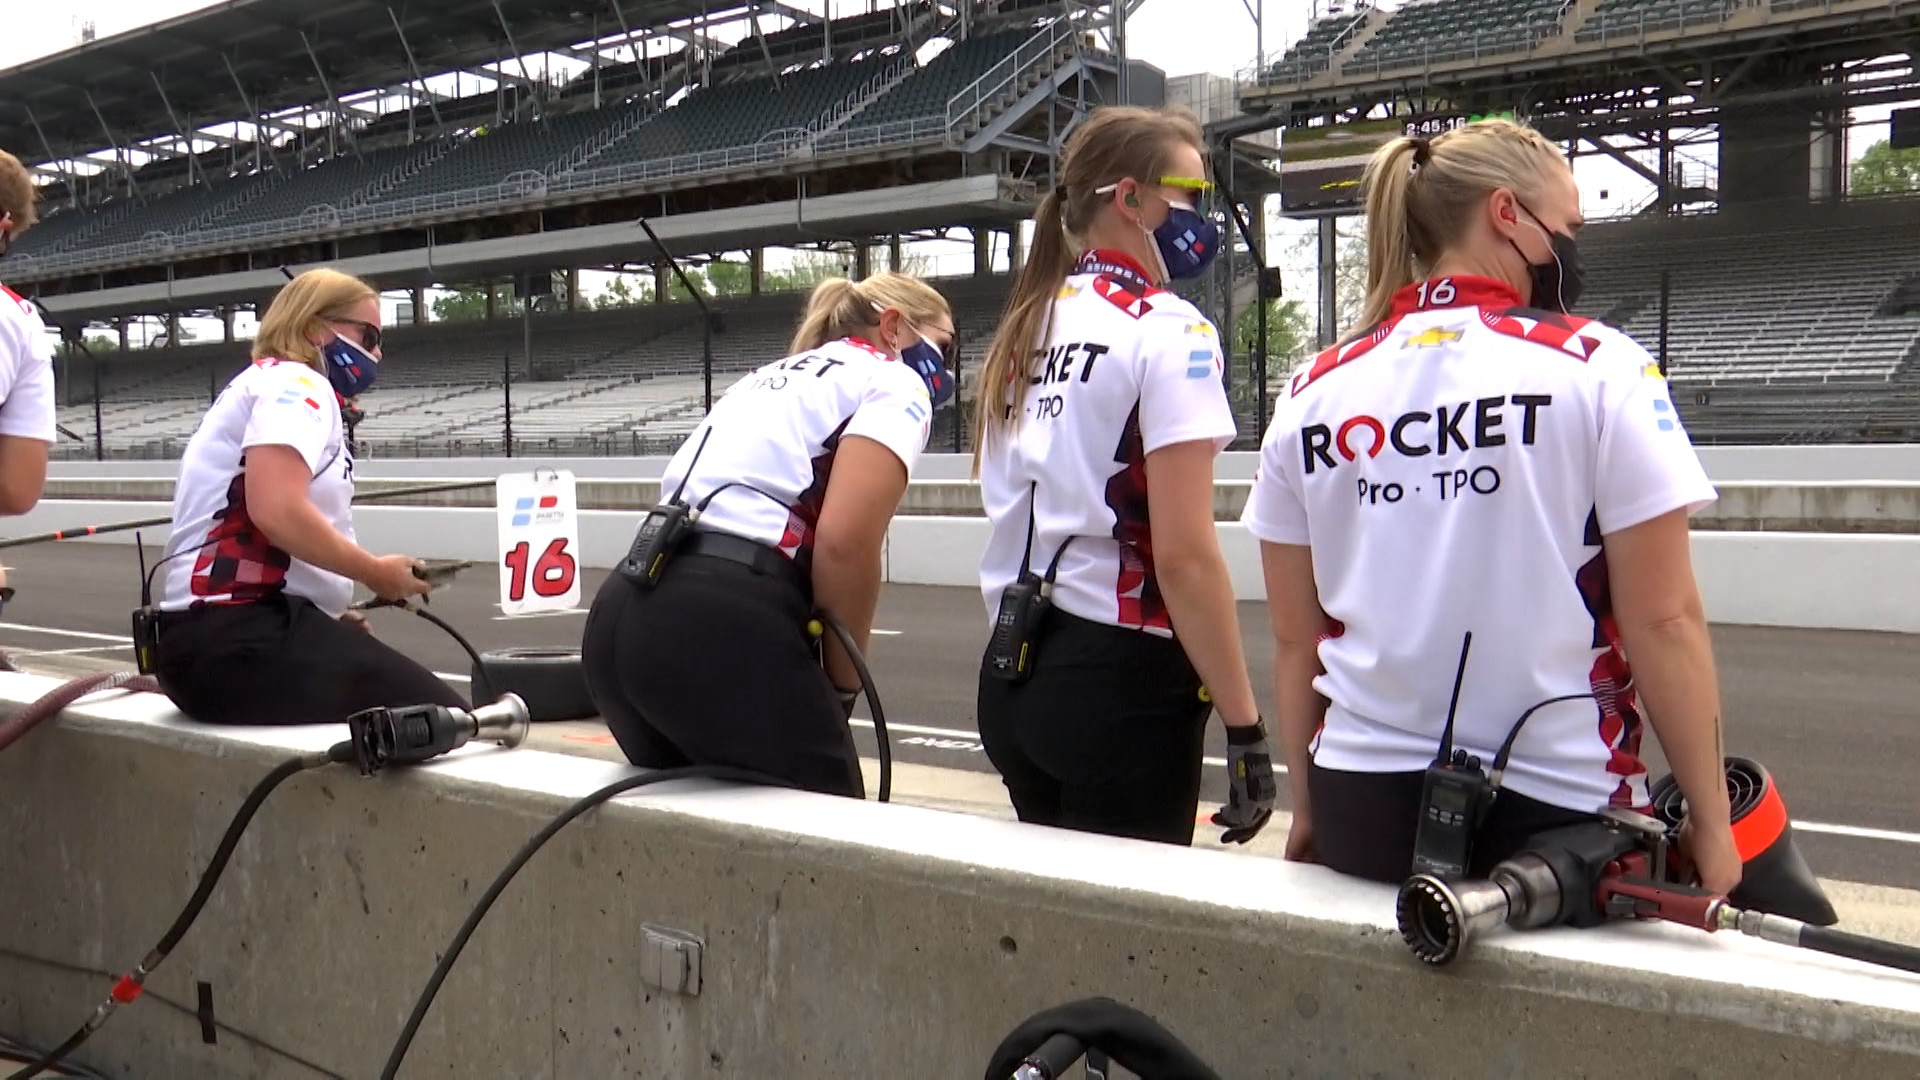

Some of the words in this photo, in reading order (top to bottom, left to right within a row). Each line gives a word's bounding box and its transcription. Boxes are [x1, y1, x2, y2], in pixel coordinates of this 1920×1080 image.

[1416, 278, 1456, 308] 16
[1036, 394, 1064, 420] TPO
[1301, 394, 1552, 474] ROCKET
[1357, 478, 1404, 505] Pro
[1432, 465, 1500, 500] TPO
[505, 537, 576, 602] 16
